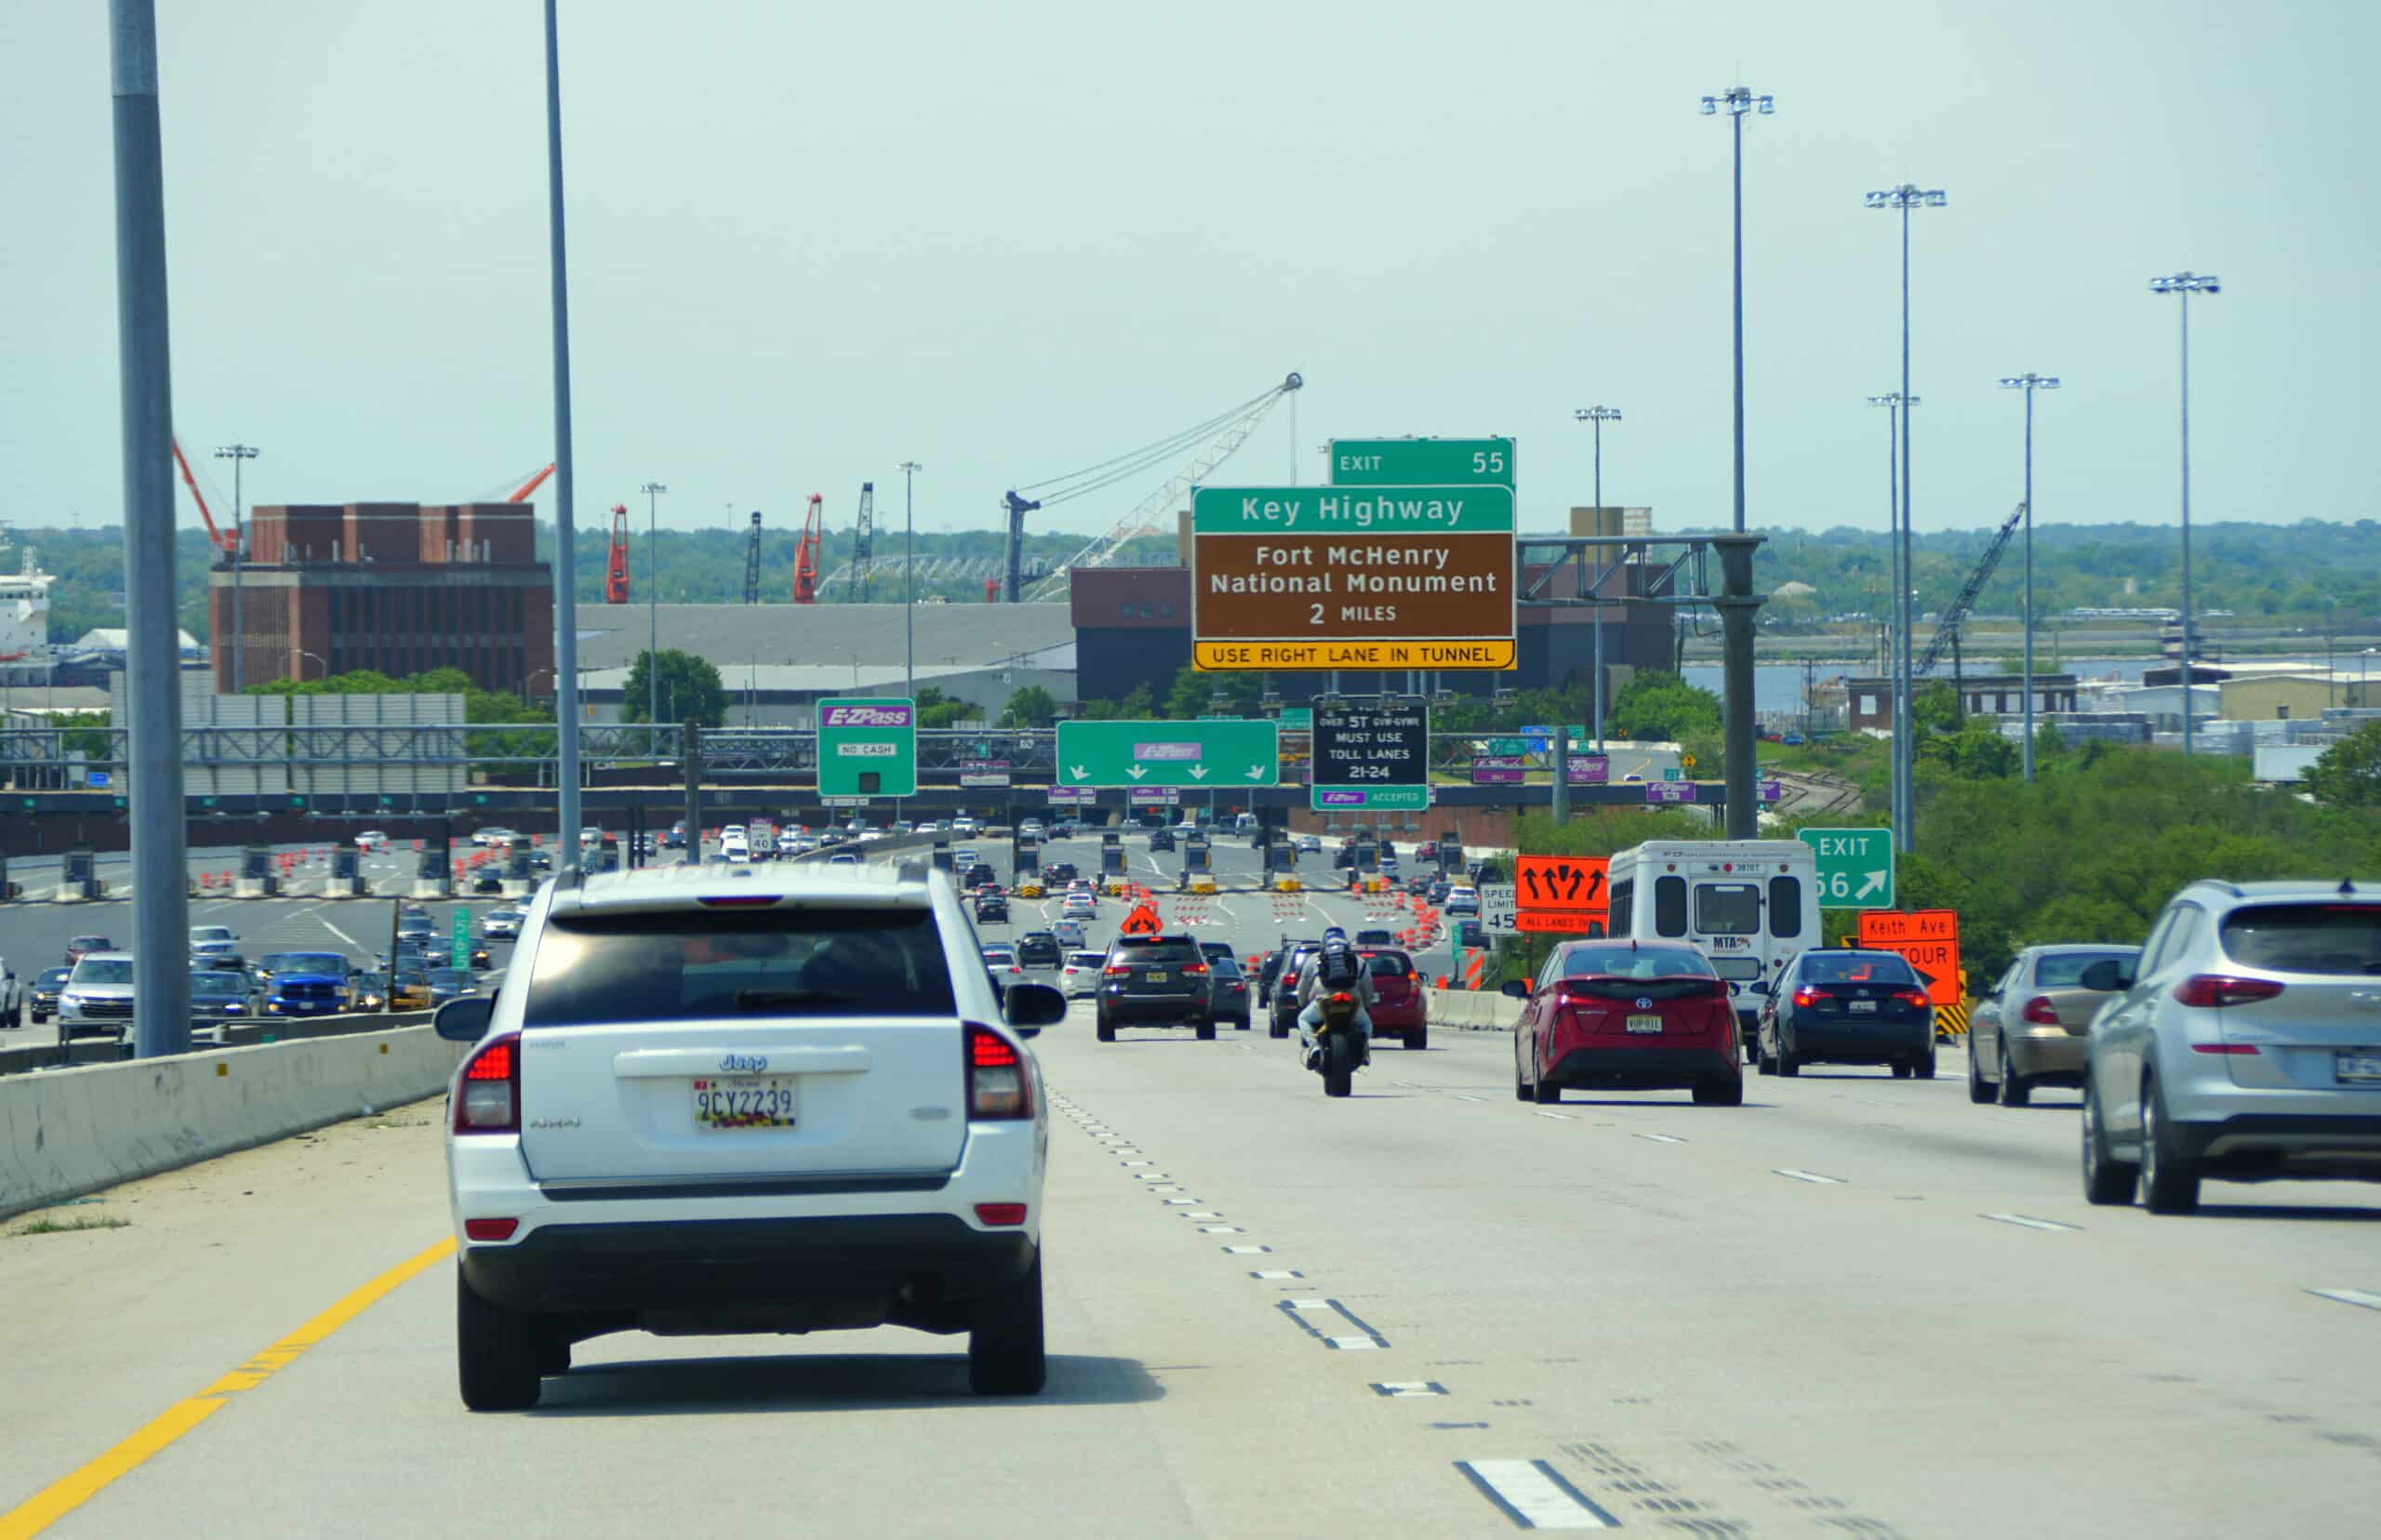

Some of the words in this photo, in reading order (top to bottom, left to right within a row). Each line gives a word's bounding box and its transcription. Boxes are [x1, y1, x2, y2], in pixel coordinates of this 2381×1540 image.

[1340, 456, 1382, 471] EXIT
[1472, 451, 1504, 473] 55
[1242, 498, 1300, 525] Key
[1319, 496, 1464, 526] Highway
[1256, 546, 1313, 565] Fort
[1327, 546, 1450, 569] McHenry
[1211, 573, 1333, 593] National
[1347, 572, 1496, 592] Monument
[1310, 604, 1325, 625] 2
[1341, 605, 1397, 621] MILES
[1213, 648, 1251, 663] USE
[1261, 648, 1317, 662] RIGHT
[1329, 648, 1379, 662] LANE
[1391, 648, 1409, 662] IN
[1421, 647, 1496, 662] TUNNEL
[828, 707, 908, 724] E-ZPass
[1336, 733, 1372, 742] MUST
[1377, 733, 1403, 742] USE
[1328, 750, 1362, 760] TOLL
[1366, 750, 1411, 760] LANES
[1349, 765, 1390, 778] 21-24
[1372, 792, 1419, 802] ACCEPTED
[1819, 838, 1870, 856] EXIT
[1816, 871, 1850, 898] 56
[1487, 899, 1514, 909] LIMIT
[1488, 913, 1516, 928] 45
[1869, 919, 1906, 936] Keith
[1920, 918, 1947, 934] Ave
[1713, 936, 1736, 948] MTA
